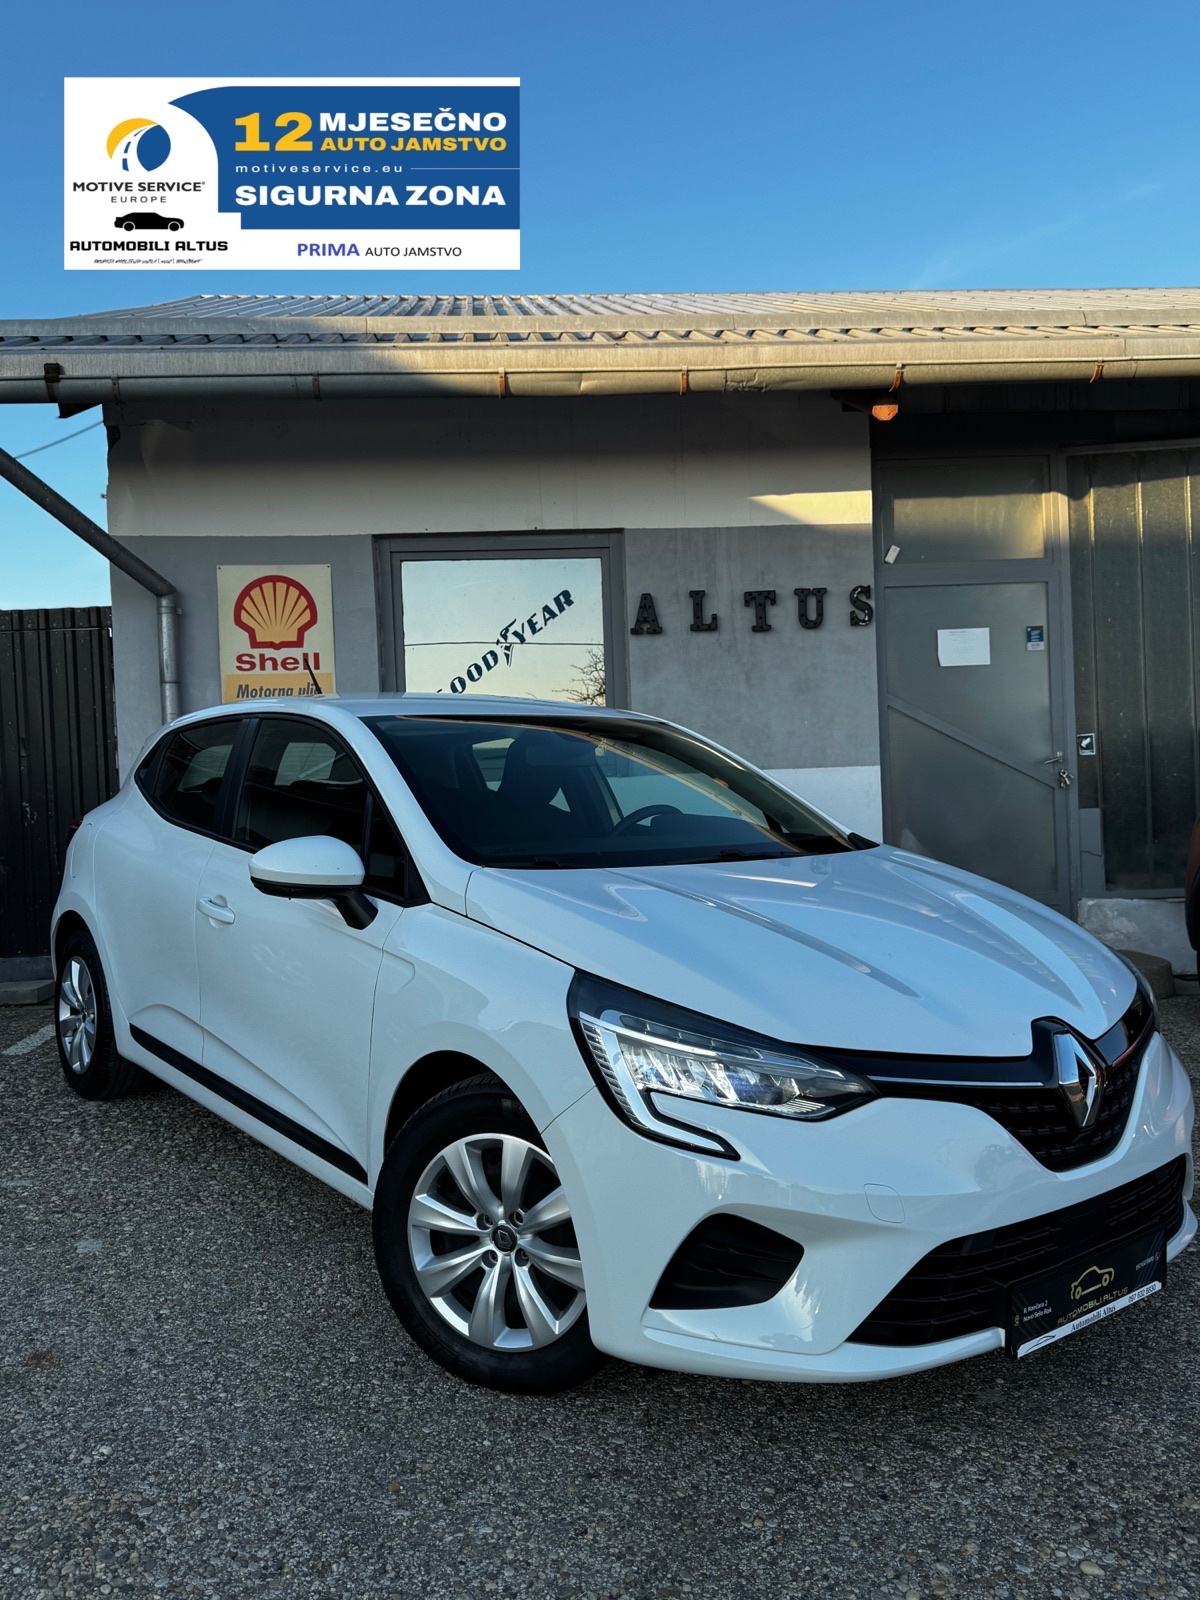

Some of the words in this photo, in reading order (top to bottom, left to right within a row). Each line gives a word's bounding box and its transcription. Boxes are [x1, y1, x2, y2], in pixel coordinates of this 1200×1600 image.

[630, 584, 875, 636] ALTUS
[436, 589, 575, 694] OODYEAR
[235, 652, 321, 672] Shell
[236, 683, 294, 699] Motorna
